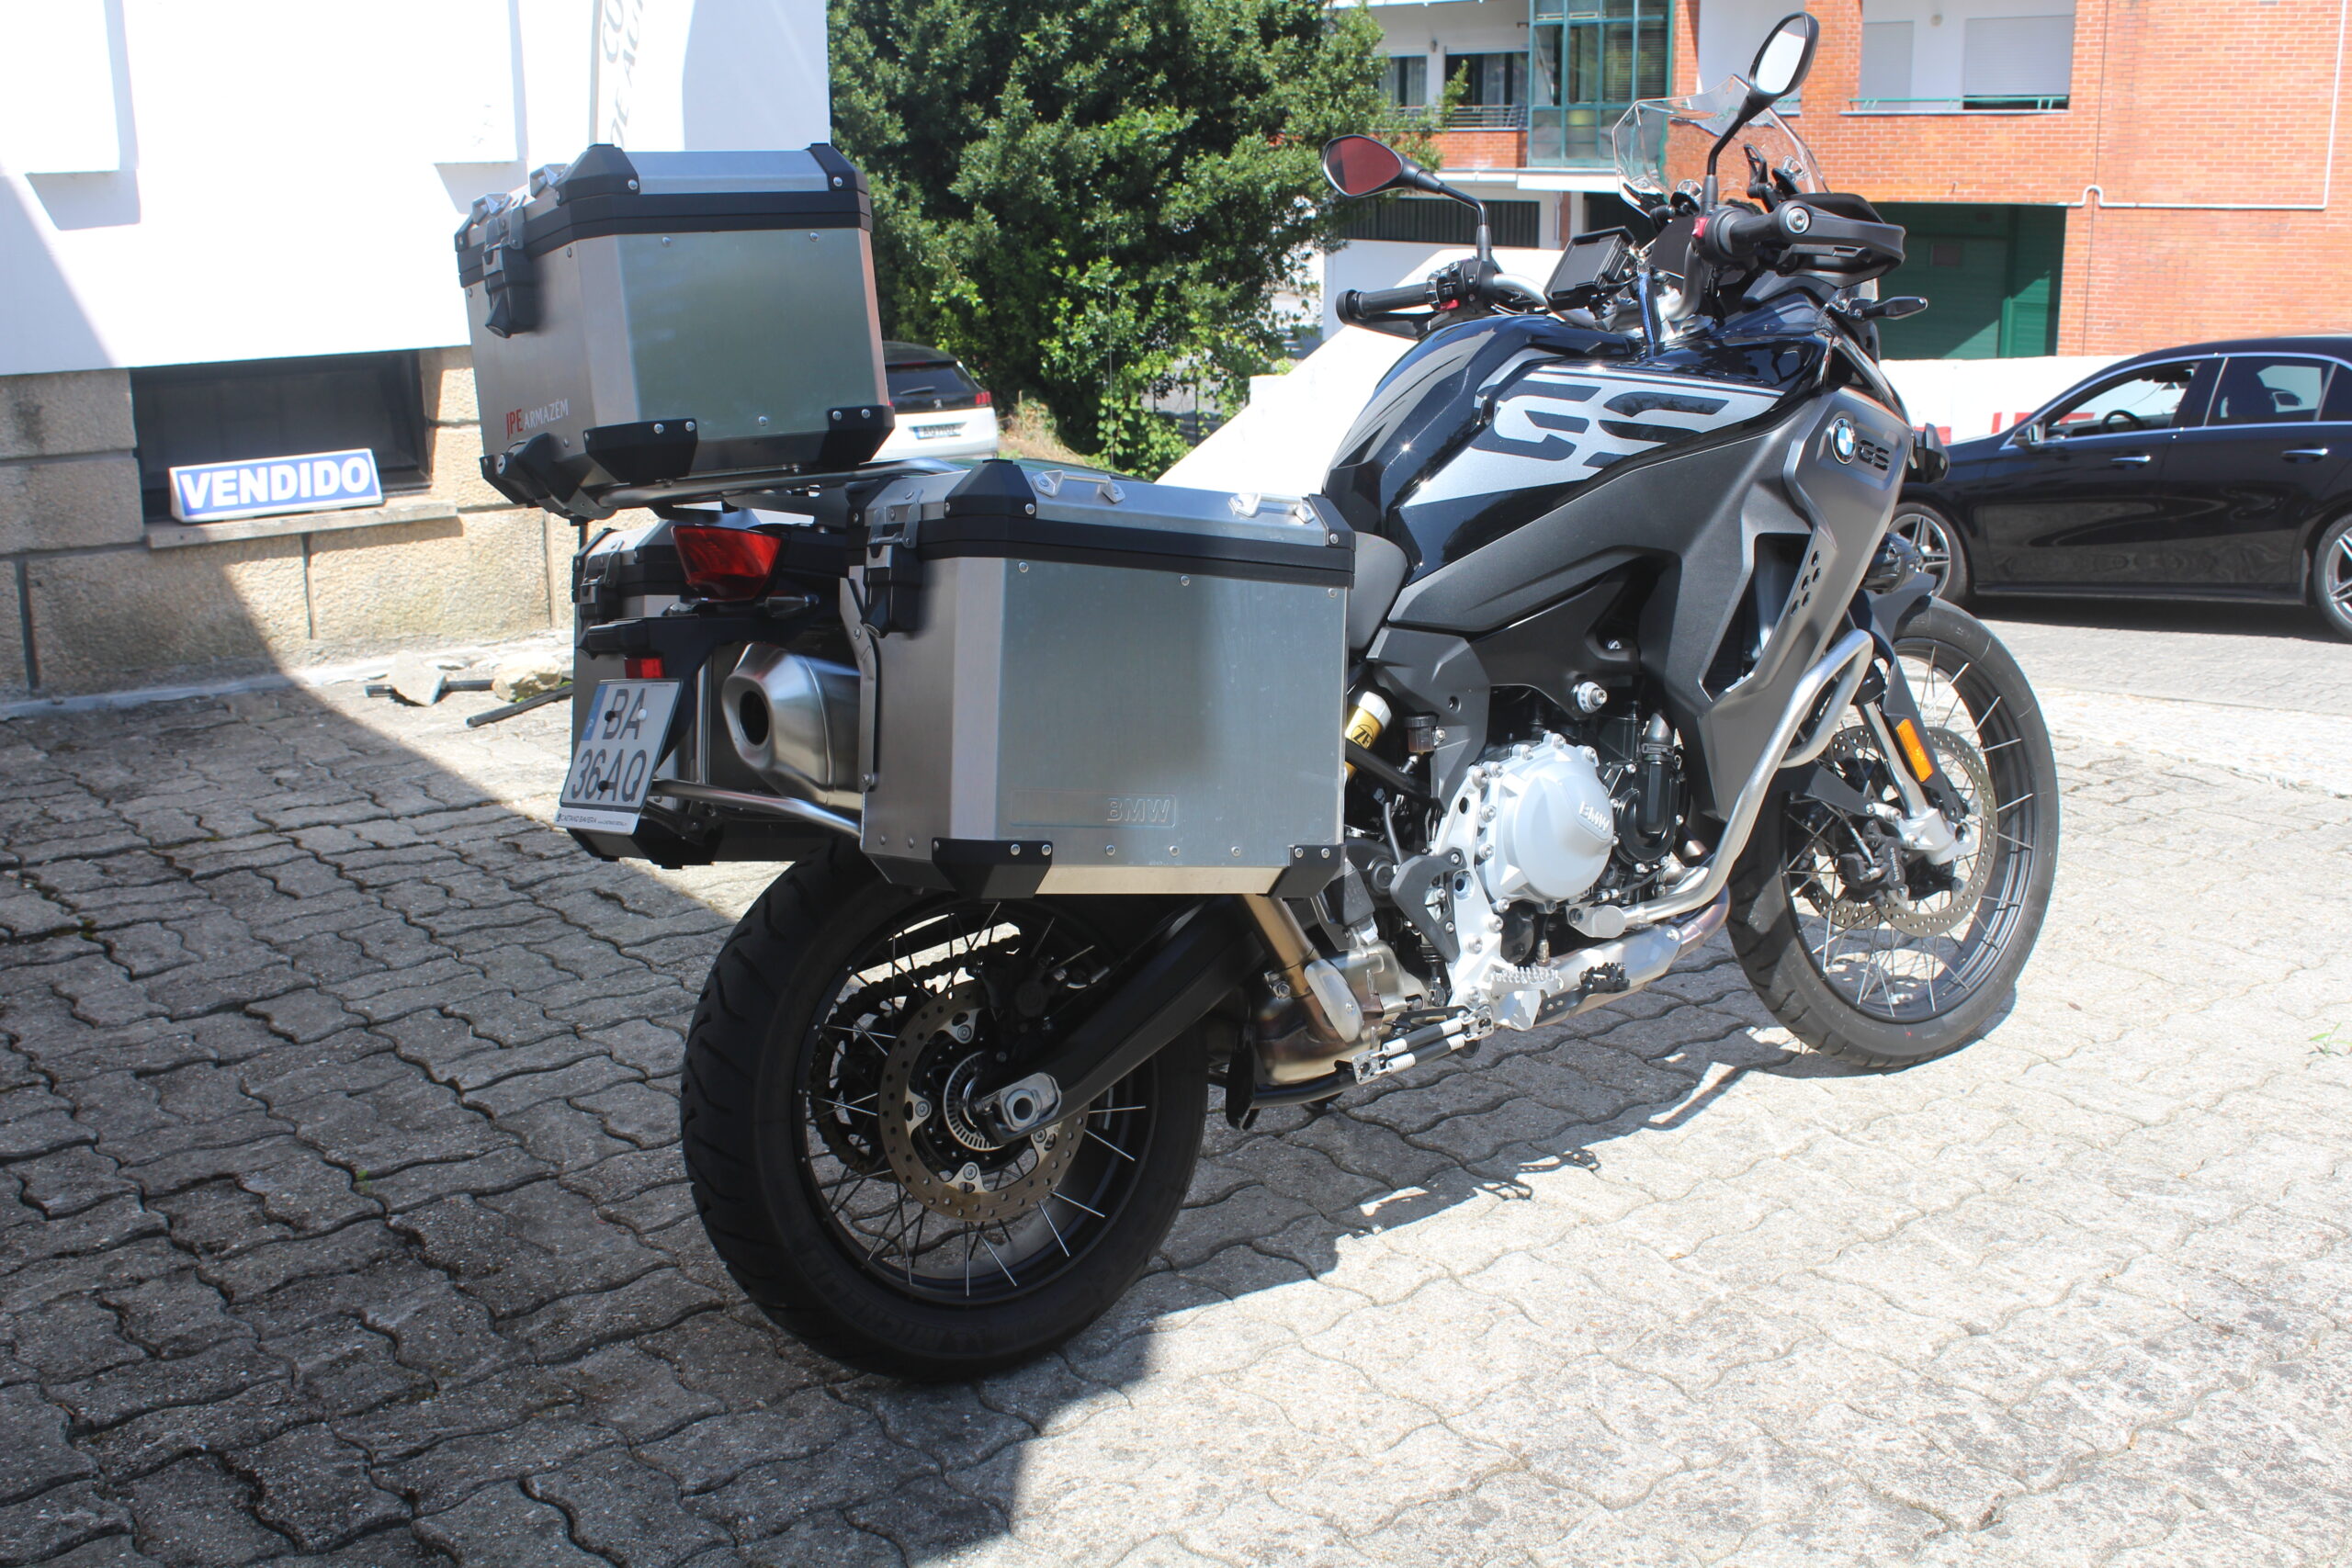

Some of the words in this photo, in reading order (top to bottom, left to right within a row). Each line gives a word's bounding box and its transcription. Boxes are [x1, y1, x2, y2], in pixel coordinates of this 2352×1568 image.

[506, 408, 524, 440] JPE
[524, 399, 569, 431] ARMAZÉM
[1468, 379, 1730, 468] GS
[1857, 440, 1890, 471] GS
[179, 457, 370, 509] VENDIDO
[602, 688, 646, 740] BA
[571, 749, 646, 802] 36AQ
[1106, 797, 1170, 823] BMW
[1579, 800, 1610, 831] BMW
[1890, 847, 1900, 882] brembo
